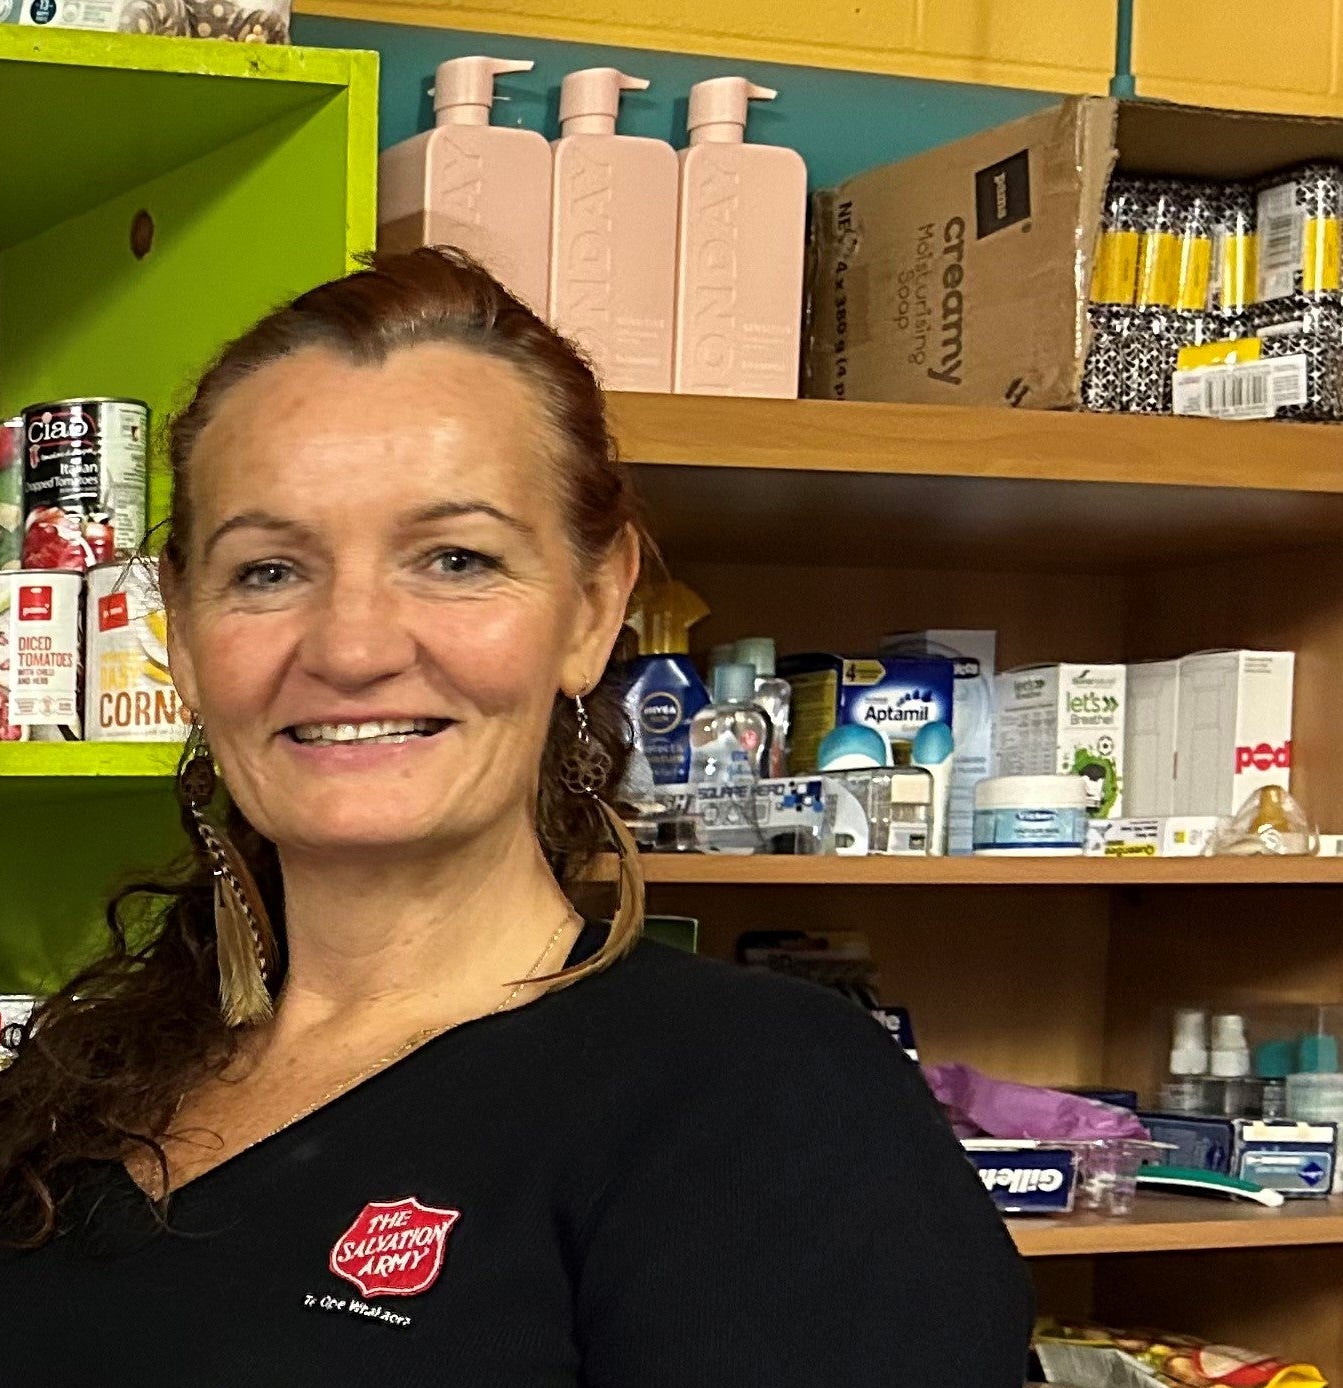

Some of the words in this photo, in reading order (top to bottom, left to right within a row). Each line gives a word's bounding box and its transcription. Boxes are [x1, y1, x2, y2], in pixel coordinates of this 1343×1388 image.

[895, 269, 915, 331] Soap
[909, 223, 936, 366] Moisturising
[928, 216, 966, 386] creamy
[27, 411, 89, 445] Ciao
[18, 636, 53, 652] DICED
[18, 652, 74, 668] TOMATOES
[99, 690, 179, 729] CORN
[864, 705, 929, 724] Aptamil
[366, 1209, 413, 1235] THE
[336, 1221, 449, 1263] SALVATION
[357, 1246, 431, 1278] ARMY
